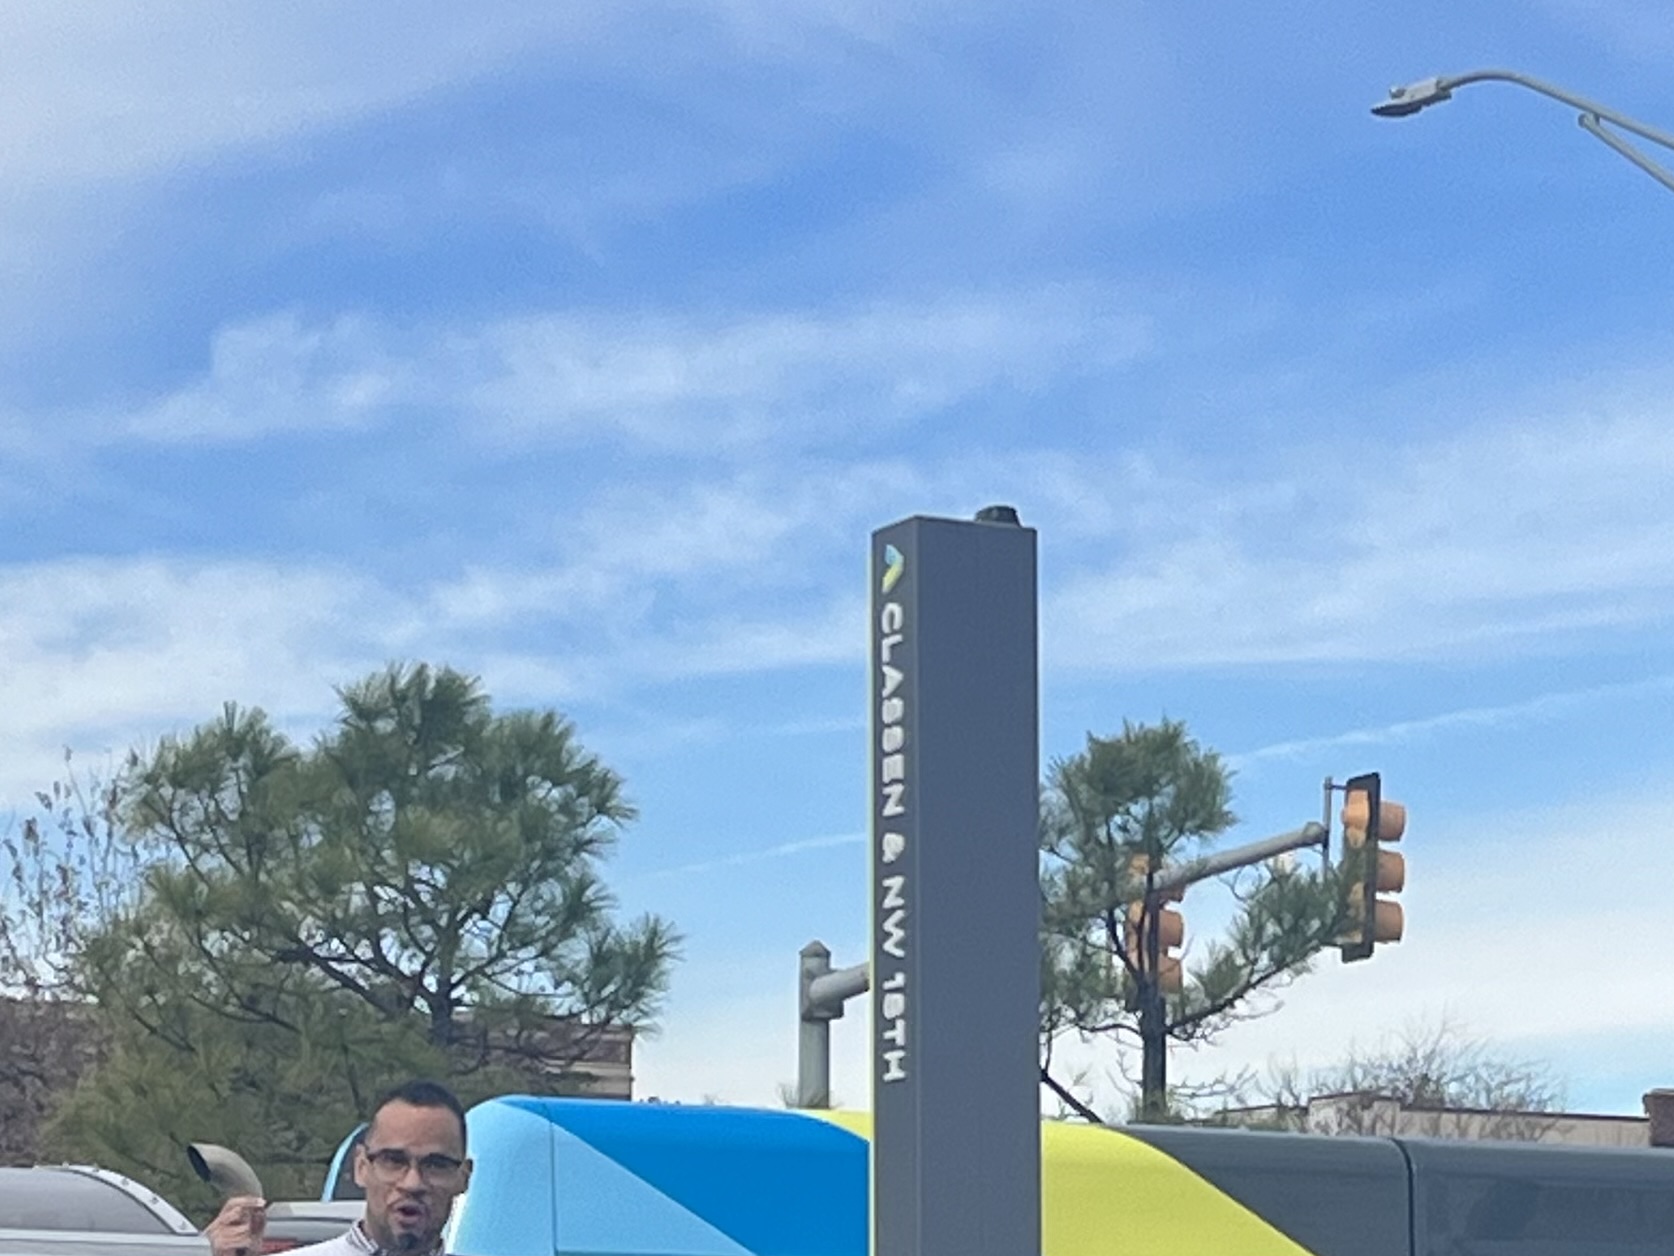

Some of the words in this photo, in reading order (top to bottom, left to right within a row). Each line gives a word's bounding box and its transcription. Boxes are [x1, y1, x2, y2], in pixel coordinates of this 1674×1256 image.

[881, 602, 905, 816] CLASSEN
[882, 832, 905, 863] &
[882, 875, 905, 958] NW
